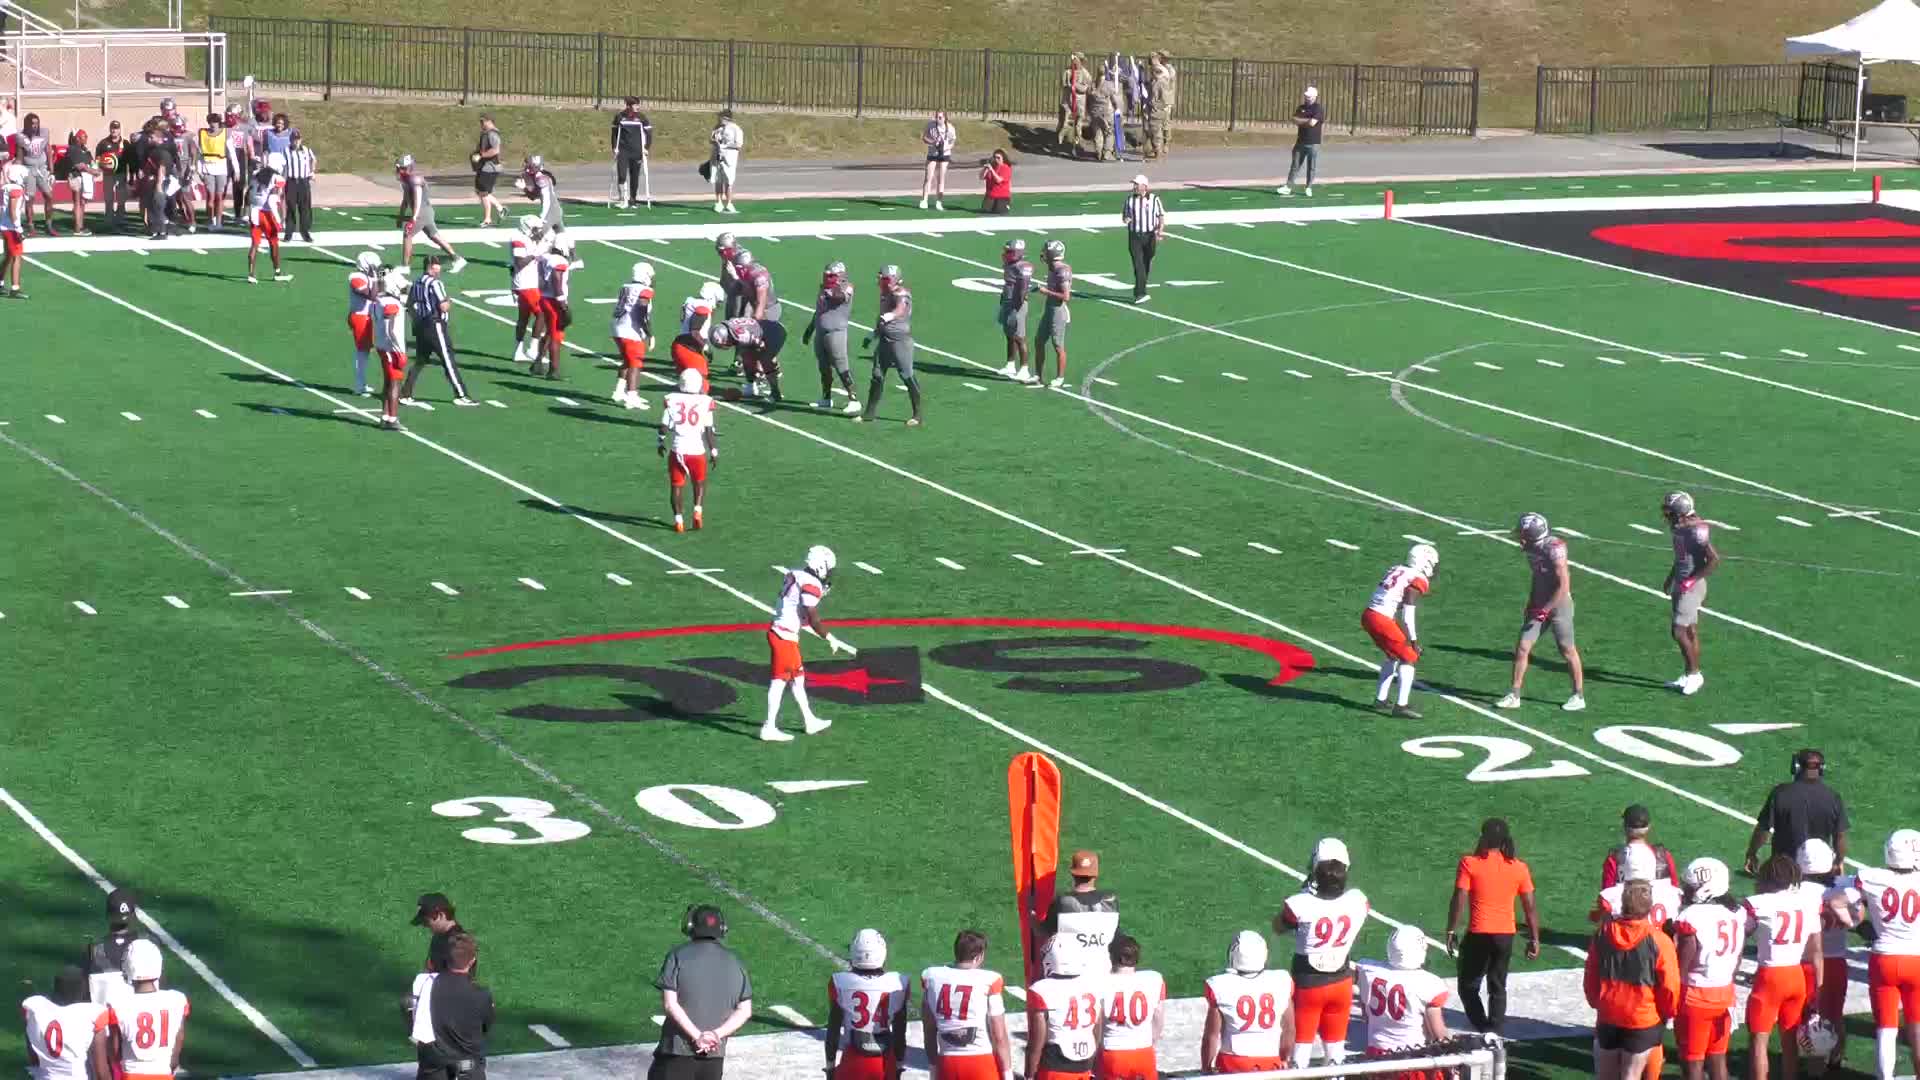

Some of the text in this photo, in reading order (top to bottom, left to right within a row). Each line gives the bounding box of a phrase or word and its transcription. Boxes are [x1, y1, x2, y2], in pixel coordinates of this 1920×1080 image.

[675, 401, 699, 426] 36
[1401, 724, 1744, 782] 20
[431, 783, 777, 845] 30
[1881, 887, 1920, 923] 90
[1313, 915, 1351, 948] 92
[1715, 919, 1739, 957] 51
[1773, 909, 1803, 945] 21
[851, 991, 890, 1029] 34
[935, 983, 973, 1021] 47
[1062, 992, 1097, 1030] 43
[1108, 990, 1148, 1027] 40
[1236, 993, 1275, 1032] 98
[1369, 976, 1408, 1021] 50
[44, 1019, 63, 1059] 0
[136, 1009, 169, 1049] 81
